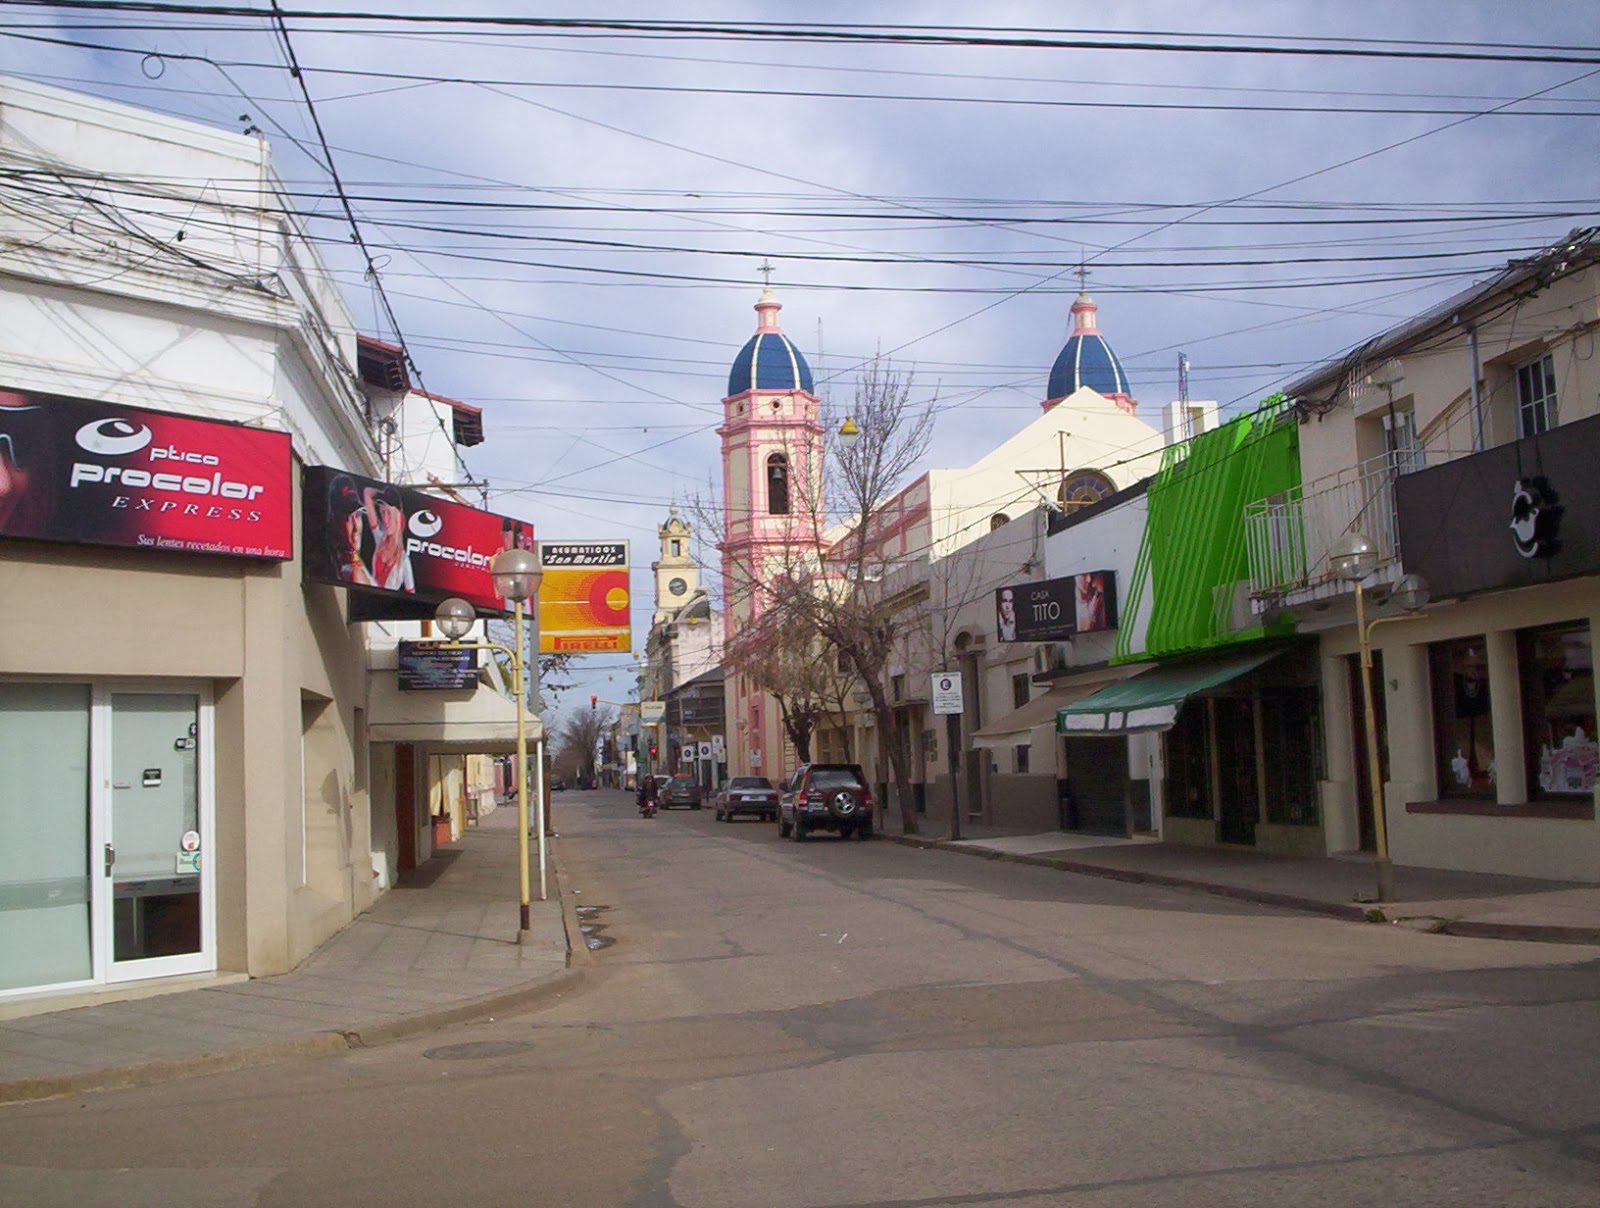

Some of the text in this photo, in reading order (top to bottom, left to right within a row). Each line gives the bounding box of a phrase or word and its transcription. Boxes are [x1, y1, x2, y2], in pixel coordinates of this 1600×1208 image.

[69, 462, 265, 501] procolor
[111, 495, 262, 522] EXPRESS
[137, 534, 155, 546] Sus
[406, 537, 492, 567] procolor
[1032, 601, 1061, 622] TITO
[554, 636, 618, 650] PIRELLI
